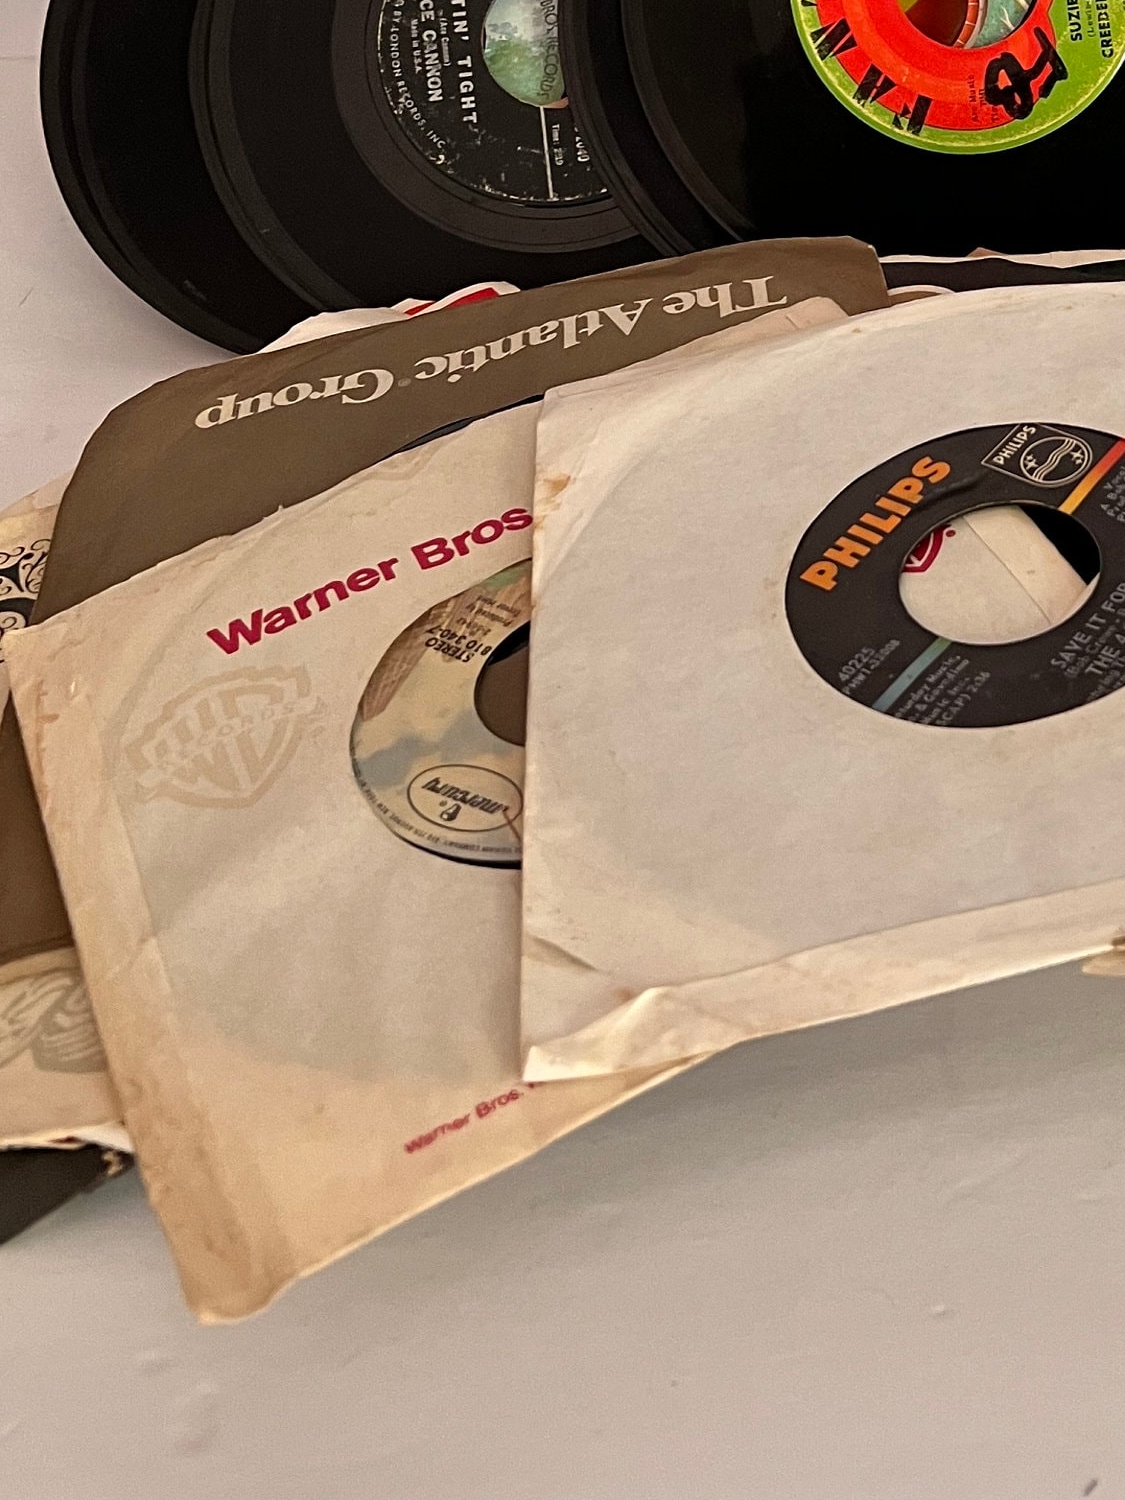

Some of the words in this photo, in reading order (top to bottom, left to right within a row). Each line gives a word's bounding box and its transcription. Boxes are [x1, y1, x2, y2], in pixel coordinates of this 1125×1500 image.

[389, 25, 403, 80] LONDON
[421, 29, 443, 102] CANNON
[456, 56, 477, 125] TIGHT
[669, 275, 789, 318] The
[415, 298, 662, 384] Atlantic
[195, 368, 396, 429] Group
[993, 422, 1037, 466] PHILIPS
[799, 455, 951, 593] PHILIPS
[206, 556, 400, 655] Warner
[411, 507, 534, 571] Bros
[424, 636, 476, 664] STEREO
[465, 638, 492, 657] 810
[836, 643, 875, 683] 40225
[1050, 627, 1092, 672] SAVE
[1085, 611, 1107, 633] IT
[1084, 641, 1122, 681] THE
[421, 776, 506, 814] mercury
[403, 1111, 470, 1155] Warner
[474, 1085, 524, 1120] Bros.
